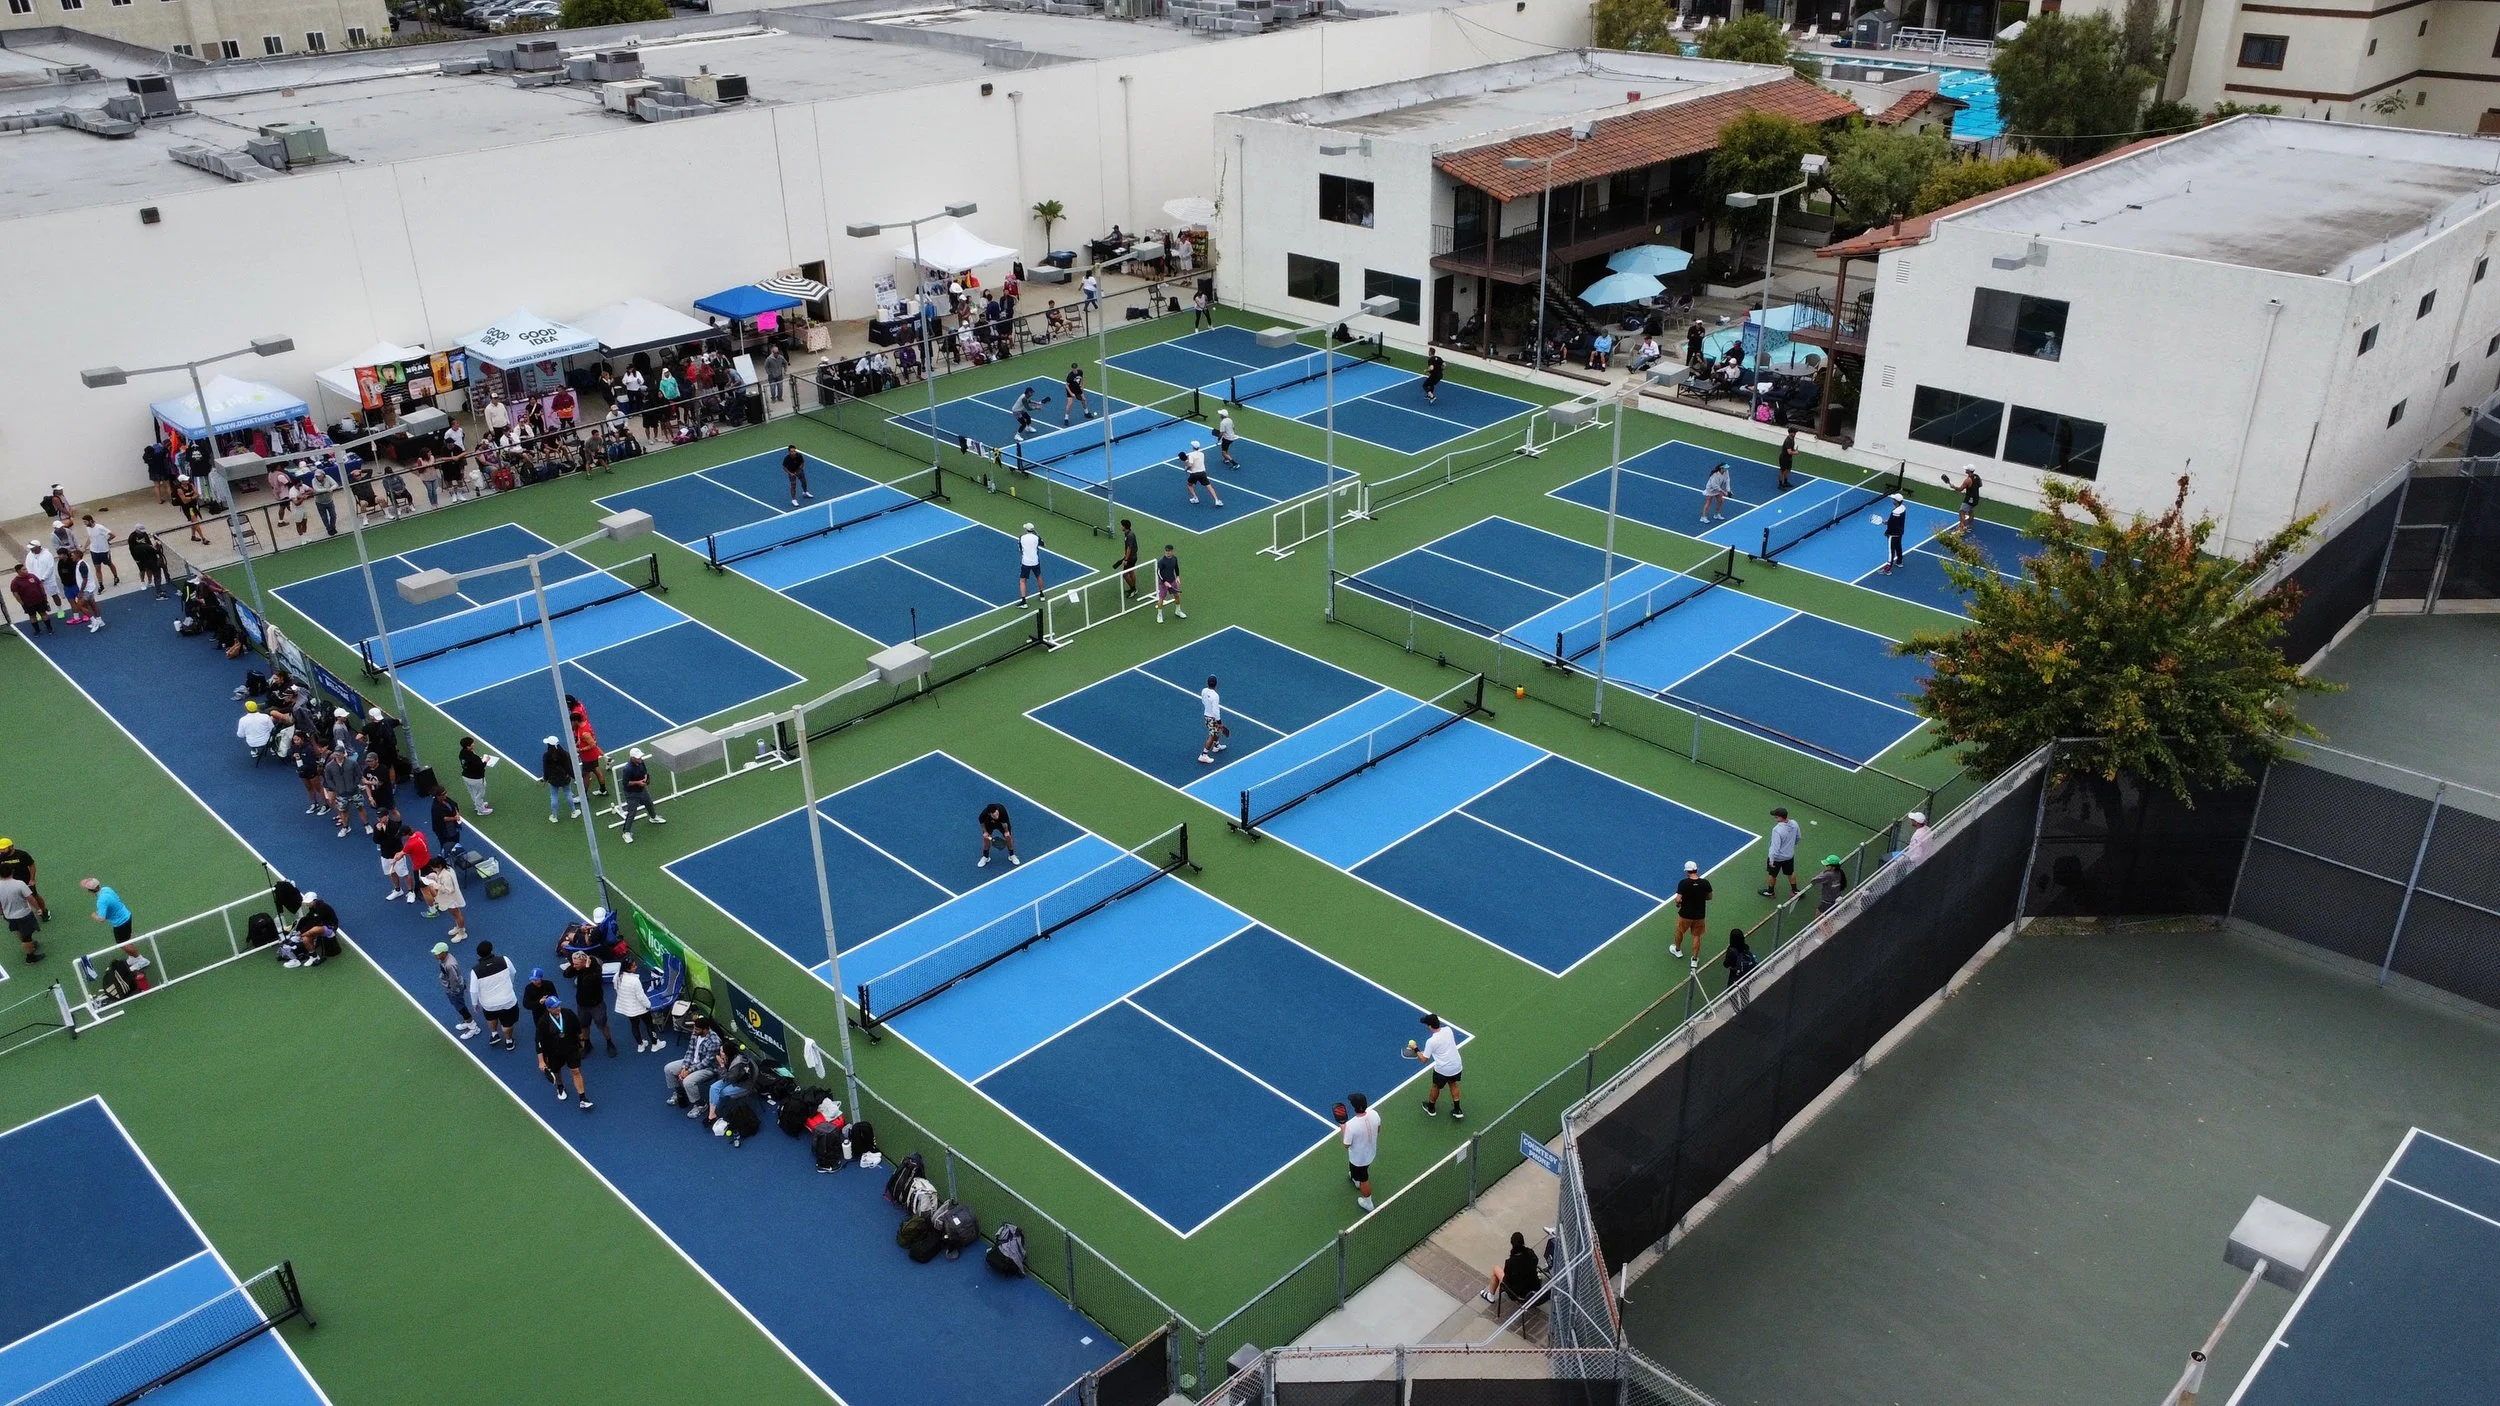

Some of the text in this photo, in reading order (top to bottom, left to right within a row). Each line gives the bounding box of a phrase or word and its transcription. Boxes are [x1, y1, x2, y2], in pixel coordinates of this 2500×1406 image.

[480, 335, 499, 347] IDEA
[486, 327, 510, 341] GOOD
[519, 328, 557, 340] GOOD
[529, 336, 559, 346] IDEA
[509, 355, 533, 365] HARNESS
[548, 347, 571, 356] NATURAL
[1523, 1138, 1558, 1164] COURTESY
[1528, 1149, 1551, 1169] PHONE
